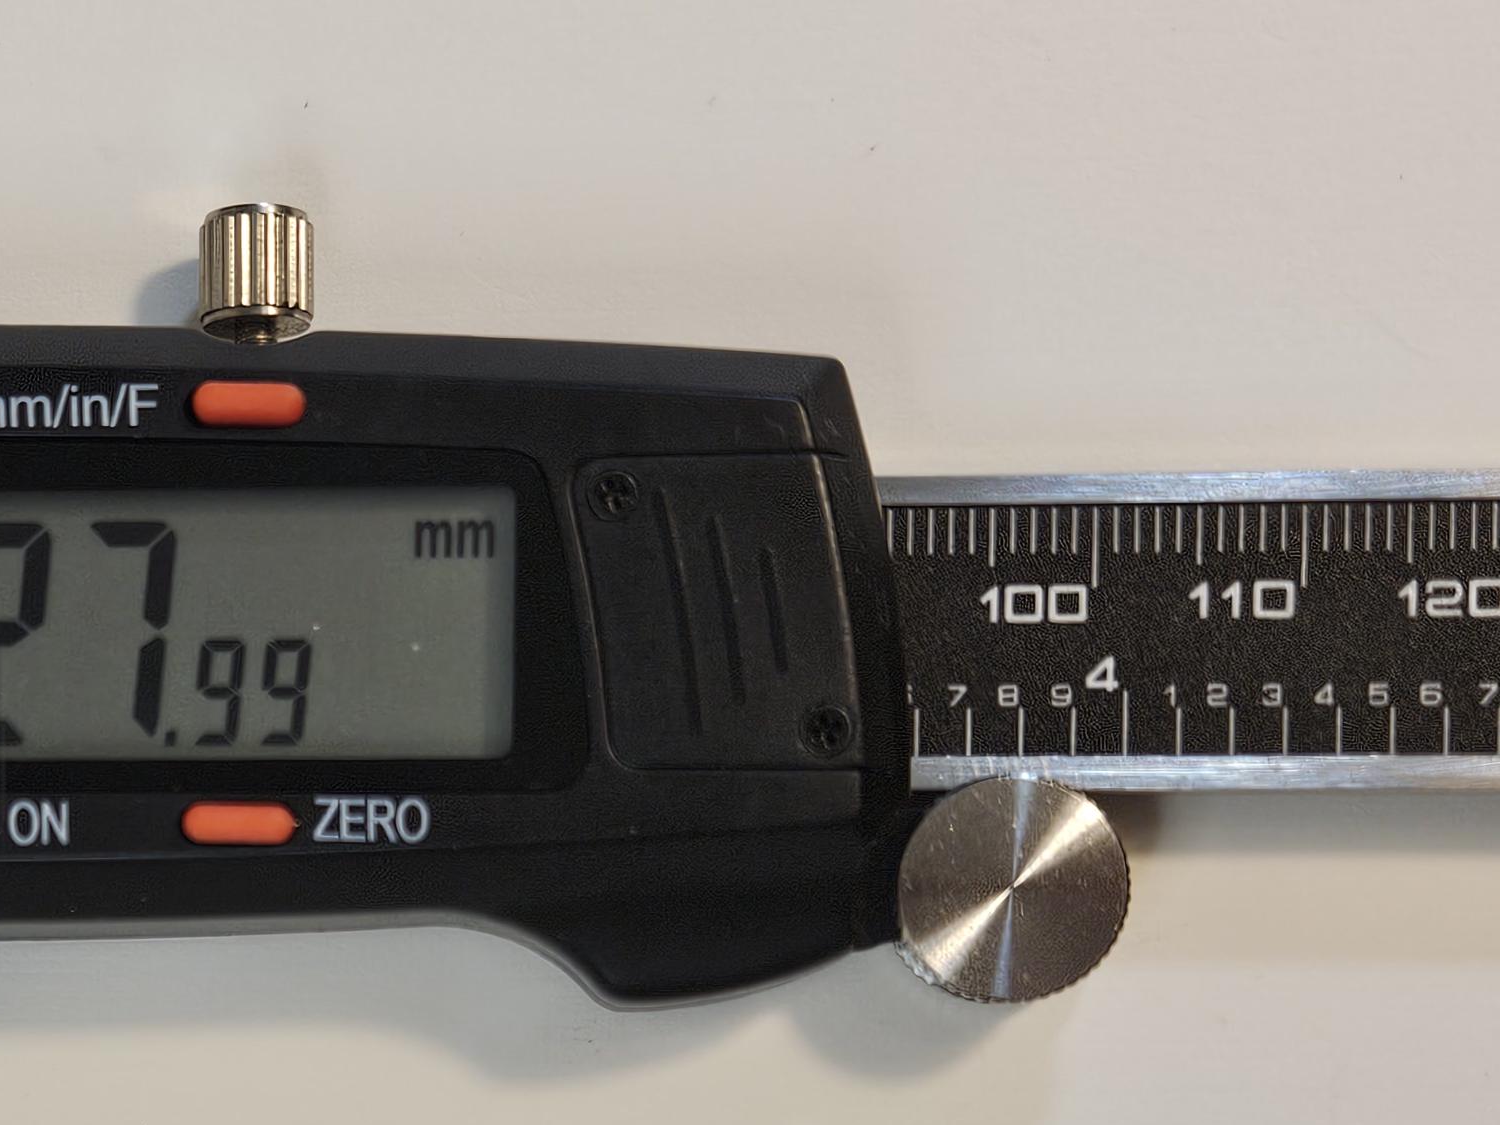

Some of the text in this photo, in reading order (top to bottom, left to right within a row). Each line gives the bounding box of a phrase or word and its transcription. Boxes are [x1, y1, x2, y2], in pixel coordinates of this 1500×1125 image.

[413, 517, 496, 561] mm
[980, 578, 1500, 623] 100 110 120
[948, 655, 1498, 706] 7 8 9 4 1 2 3 4 5 6 7
[9, 801, 68, 845] ON
[314, 798, 428, 842] ZERO
